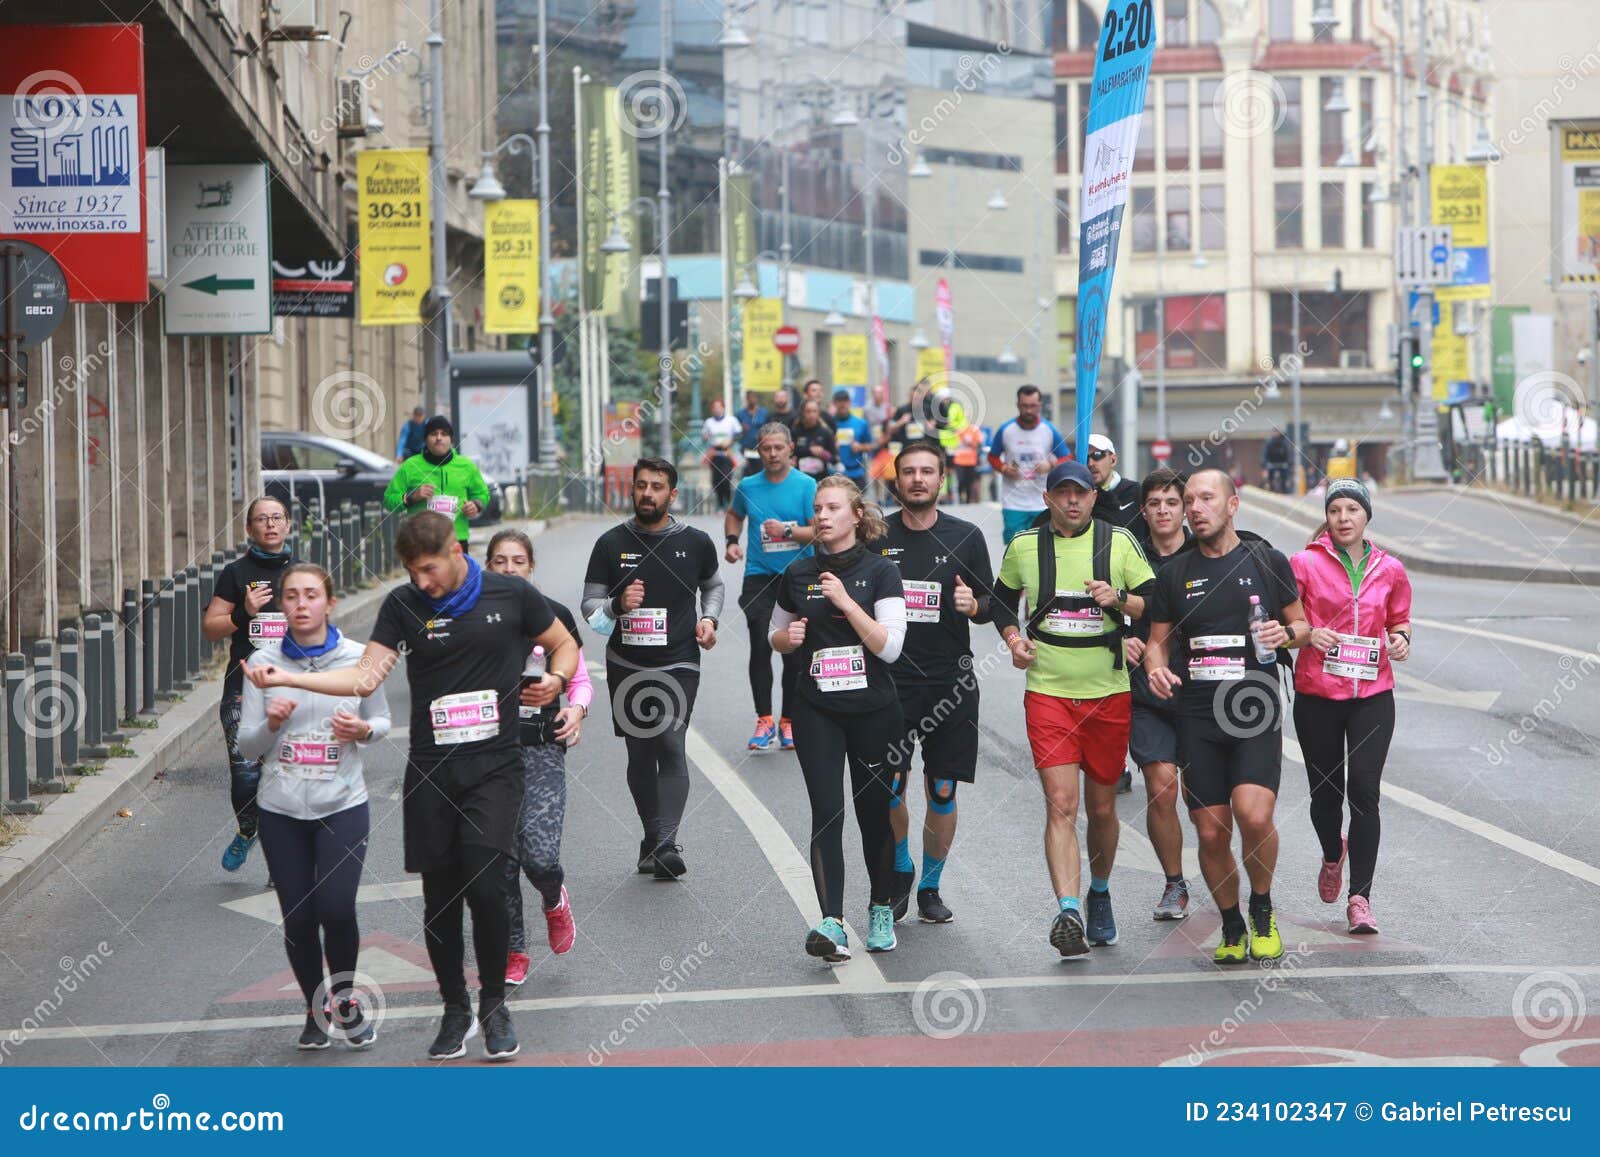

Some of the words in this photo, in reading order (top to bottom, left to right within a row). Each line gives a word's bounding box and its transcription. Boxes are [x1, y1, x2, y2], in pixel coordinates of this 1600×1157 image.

[1103, 1, 1150, 62] 2:20
[1097, 65, 1145, 97] HALFMARATHON
[16, 98, 82, 118] INOX
[91, 98, 124, 118] SA
[14, 195, 67, 215] Since
[75, 195, 122, 214] 1937
[368, 203, 421, 218] 30-31
[1439, 205, 1481, 218] 30-31
[14, 218, 127, 231] www.inoxsa.ro
[182, 225, 248, 241] ATELIER
[172, 242, 259, 257] CROITORIE
[493, 240, 532, 253] 30-31
